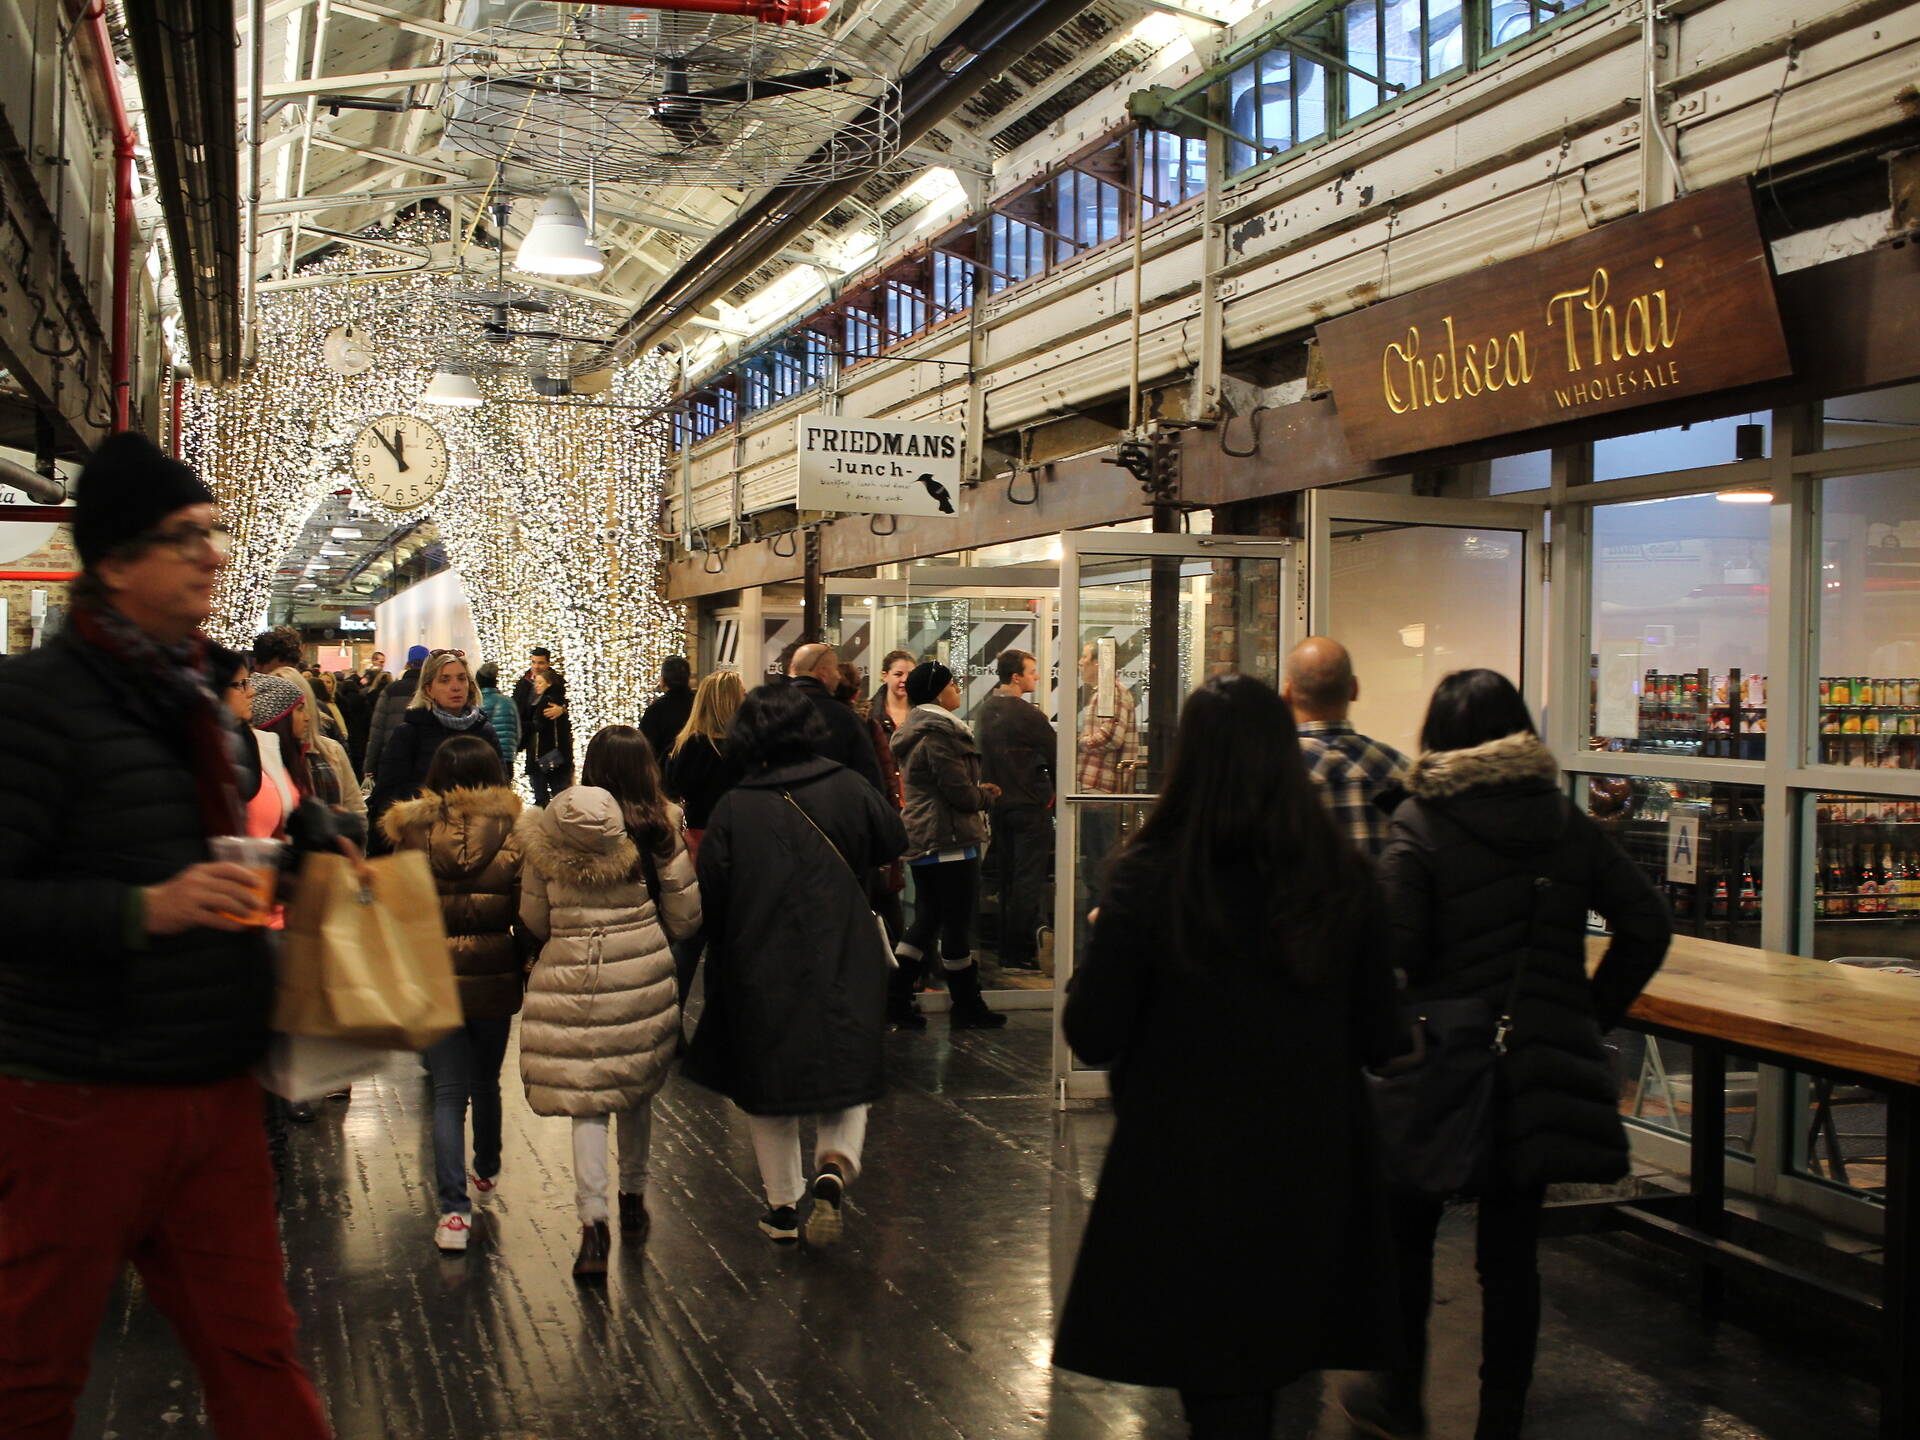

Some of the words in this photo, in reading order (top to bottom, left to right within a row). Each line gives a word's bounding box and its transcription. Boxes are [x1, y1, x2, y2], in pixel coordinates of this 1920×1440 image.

[1382, 316, 1537, 414] Chelsea
[1547, 256, 1681, 372] Thai
[1554, 361, 1681, 408] WHOLESALE
[368, 436, 378, 448] 10
[426, 438, 434, 449] 2
[807, 427, 956, 459] FRIEDMANS
[362, 454, 370, 466] 9
[431, 456, 438, 468] 3
[367, 472, 375, 484] 8
[424, 474, 433, 485] 4
[382, 484, 391, 497] 7
[396, 489, 404, 501] 6
[410, 485, 419, 496] 5
[1674, 825, 1692, 866] A
